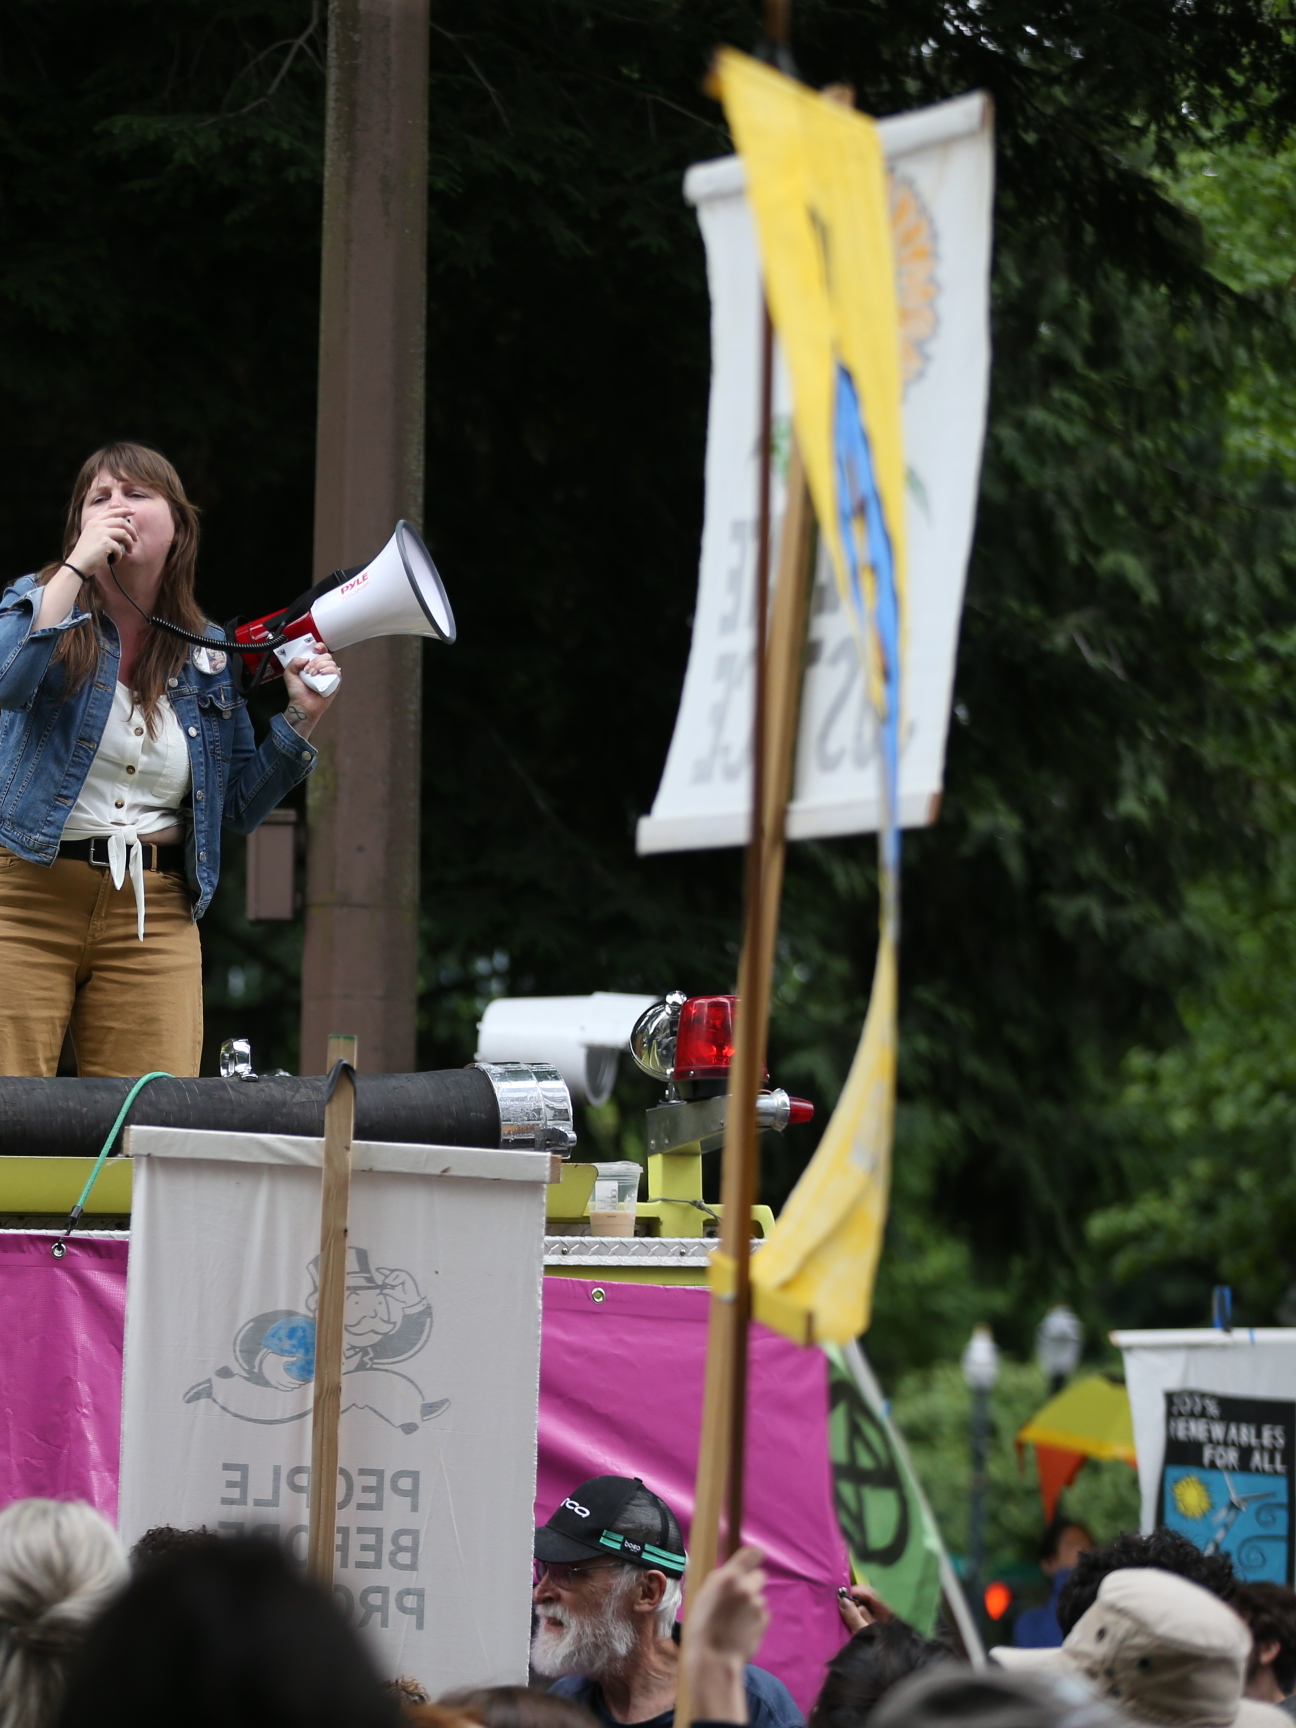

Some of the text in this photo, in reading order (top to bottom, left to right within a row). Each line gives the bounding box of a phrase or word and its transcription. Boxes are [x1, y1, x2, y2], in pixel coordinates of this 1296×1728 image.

[340, 571, 369, 595] PYLE
[1202, 1442, 1287, 1474] FOR ALL
